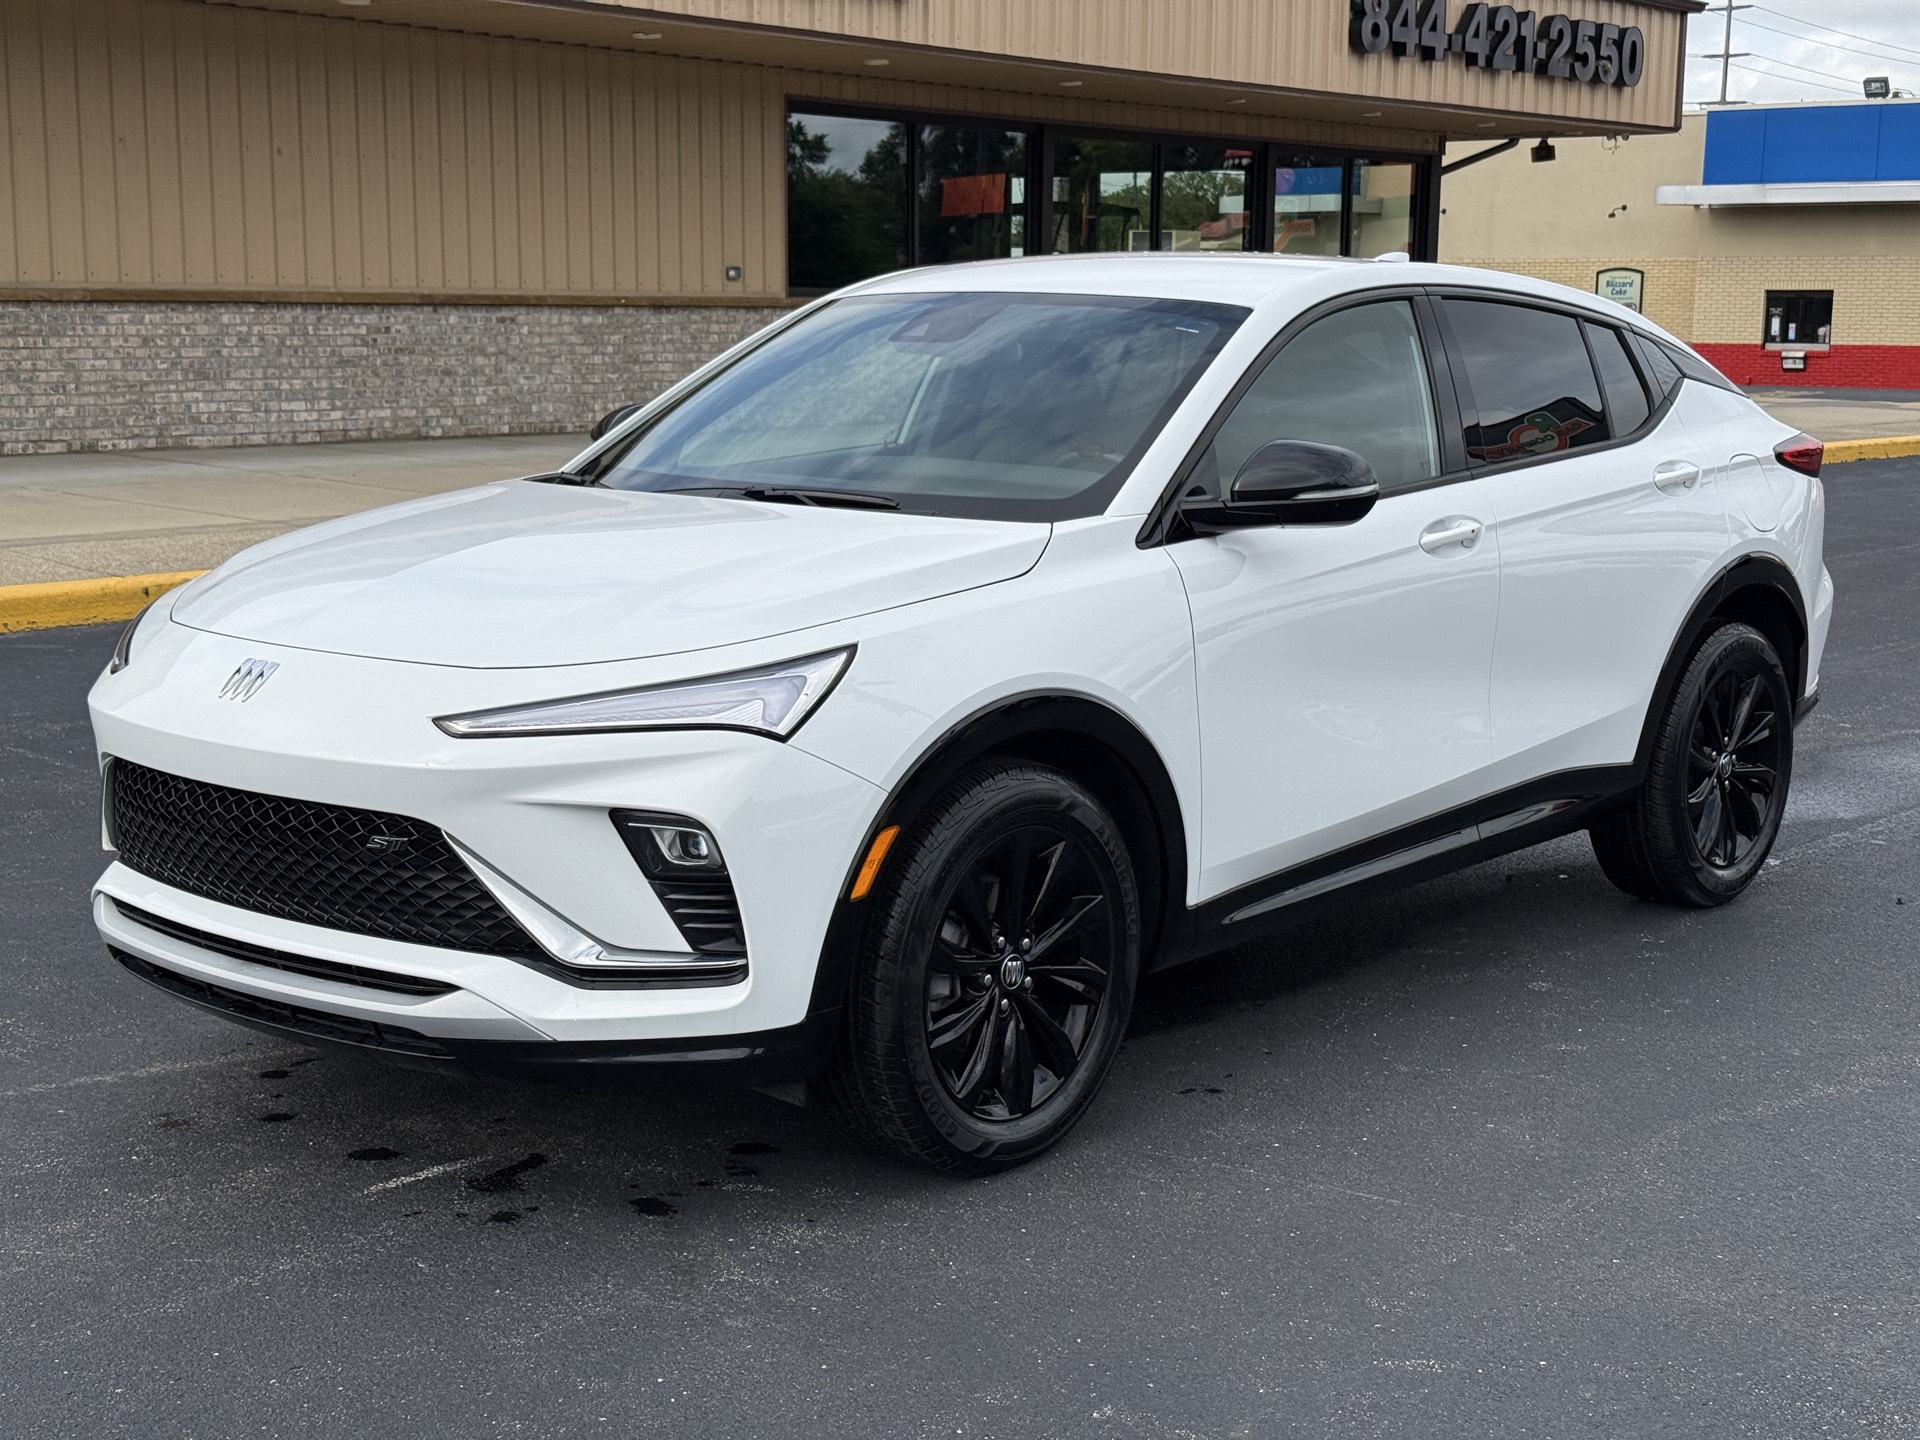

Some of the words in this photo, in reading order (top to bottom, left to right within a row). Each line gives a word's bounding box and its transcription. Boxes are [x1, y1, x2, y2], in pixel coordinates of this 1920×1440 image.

[1605, 279, 1634, 288] Blizzard
[1610, 287, 1628, 296] Cake
[366, 835, 410, 851] ST
